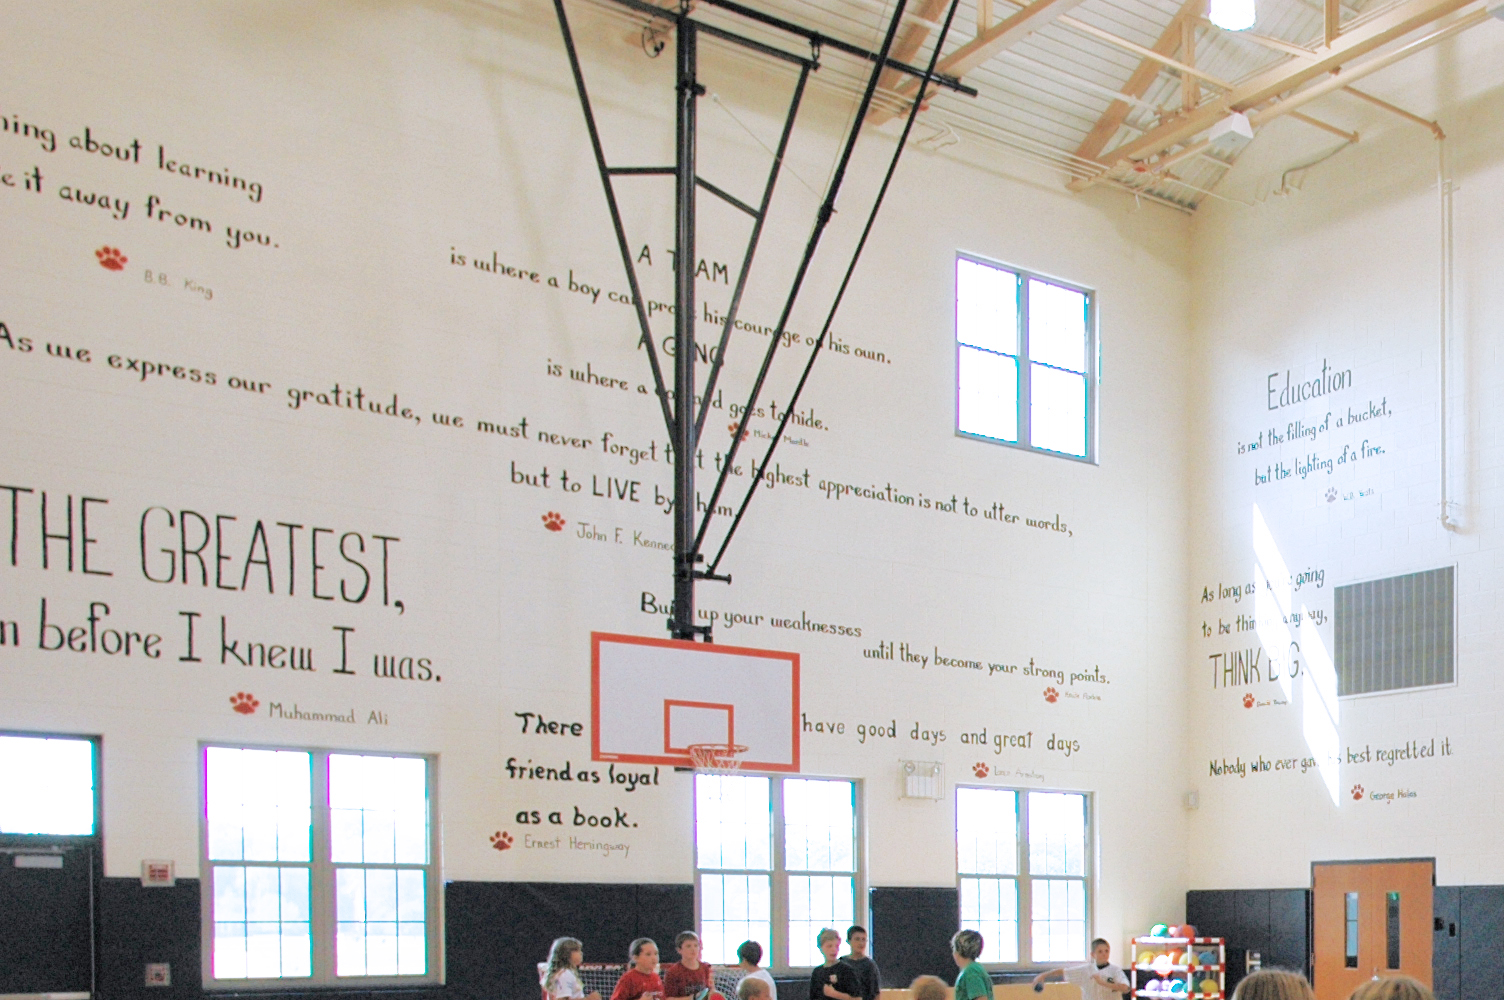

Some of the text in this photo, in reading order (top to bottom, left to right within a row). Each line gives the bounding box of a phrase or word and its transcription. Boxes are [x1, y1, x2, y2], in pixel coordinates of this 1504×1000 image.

[69, 127, 142, 165] about
[157, 145, 264, 203] learning
[24, 165, 281, 250] it away from you.
[638, 244, 729, 286] A TAM
[183, 276, 214, 301] King
[450, 246, 467, 267] is
[473, 251, 540, 284] where
[547, 273, 559, 290] a
[568, 269, 601, 304] boy
[703, 301, 728, 328] his
[734, 318, 801, 348] courge
[828, 331, 851, 357] his
[855, 343, 892, 365] own.
[662, 336, 725, 368] GNG
[547, 358, 563, 379] is
[570, 362, 629, 392] where
[637, 383, 648, 395] a
[1267, 357, 1352, 412] Education
[0, 321, 34, 354] As
[45, 340, 93, 364] we
[107, 350, 218, 386] express
[227, 375, 273, 395] our
[286, 382, 422, 425] gratitude,
[432, 411, 464, 430] we
[477, 416, 530, 441] must
[537, 431, 592, 451] never
[601, 430, 659, 466] forget
[665, 443, 705, 470] tt
[714, 451, 744, 477] the
[818, 476, 915, 508] appreciation
[918, 492, 932, 510] is
[934, 495, 958, 515] not
[963, 496, 979, 518] to
[984, 501, 1019, 526] utter
[1026, 513, 1074, 538] words,
[1236, 395, 1393, 456] is not the filling of a bucket,
[510, 460, 550, 490] but
[560, 468, 582, 494] to
[592, 473, 642, 504] LIVE
[1254, 438, 1386, 487] but the lighting of a fire.
[0, 484, 405, 615] THE GREATEST,
[577, 521, 608, 544] John
[632, 529, 676, 552] Kenne
[1200, 566, 1325, 605] As long as going
[38, 596, 443, 684] before I knew I was.
[698, 606, 720, 630] up
[725, 611, 764, 630] your
[770, 610, 863, 638] weaknesses
[1201, 621, 1212, 638] to
[1218, 618, 1231, 636] be
[863, 640, 1111, 687] until they become your strong points.
[1208, 646, 1261, 690] THINK
[269, 702, 389, 727] Muhammad Ali
[514, 712, 584, 738] There
[801, 713, 1081, 758] have good days and great days
[505, 757, 660, 793] friend as loyal
[1208, 755, 1247, 779] Nobody
[1249, 754, 1272, 774] who
[1274, 756, 1298, 771] ever
[1300, 755, 1321, 775] gav
[1347, 744, 1371, 764] best
[1375, 736, 1436, 768] regretted
[515, 804, 639, 830] as a book.
[524, 835, 631, 860] Ernest Hemingway
